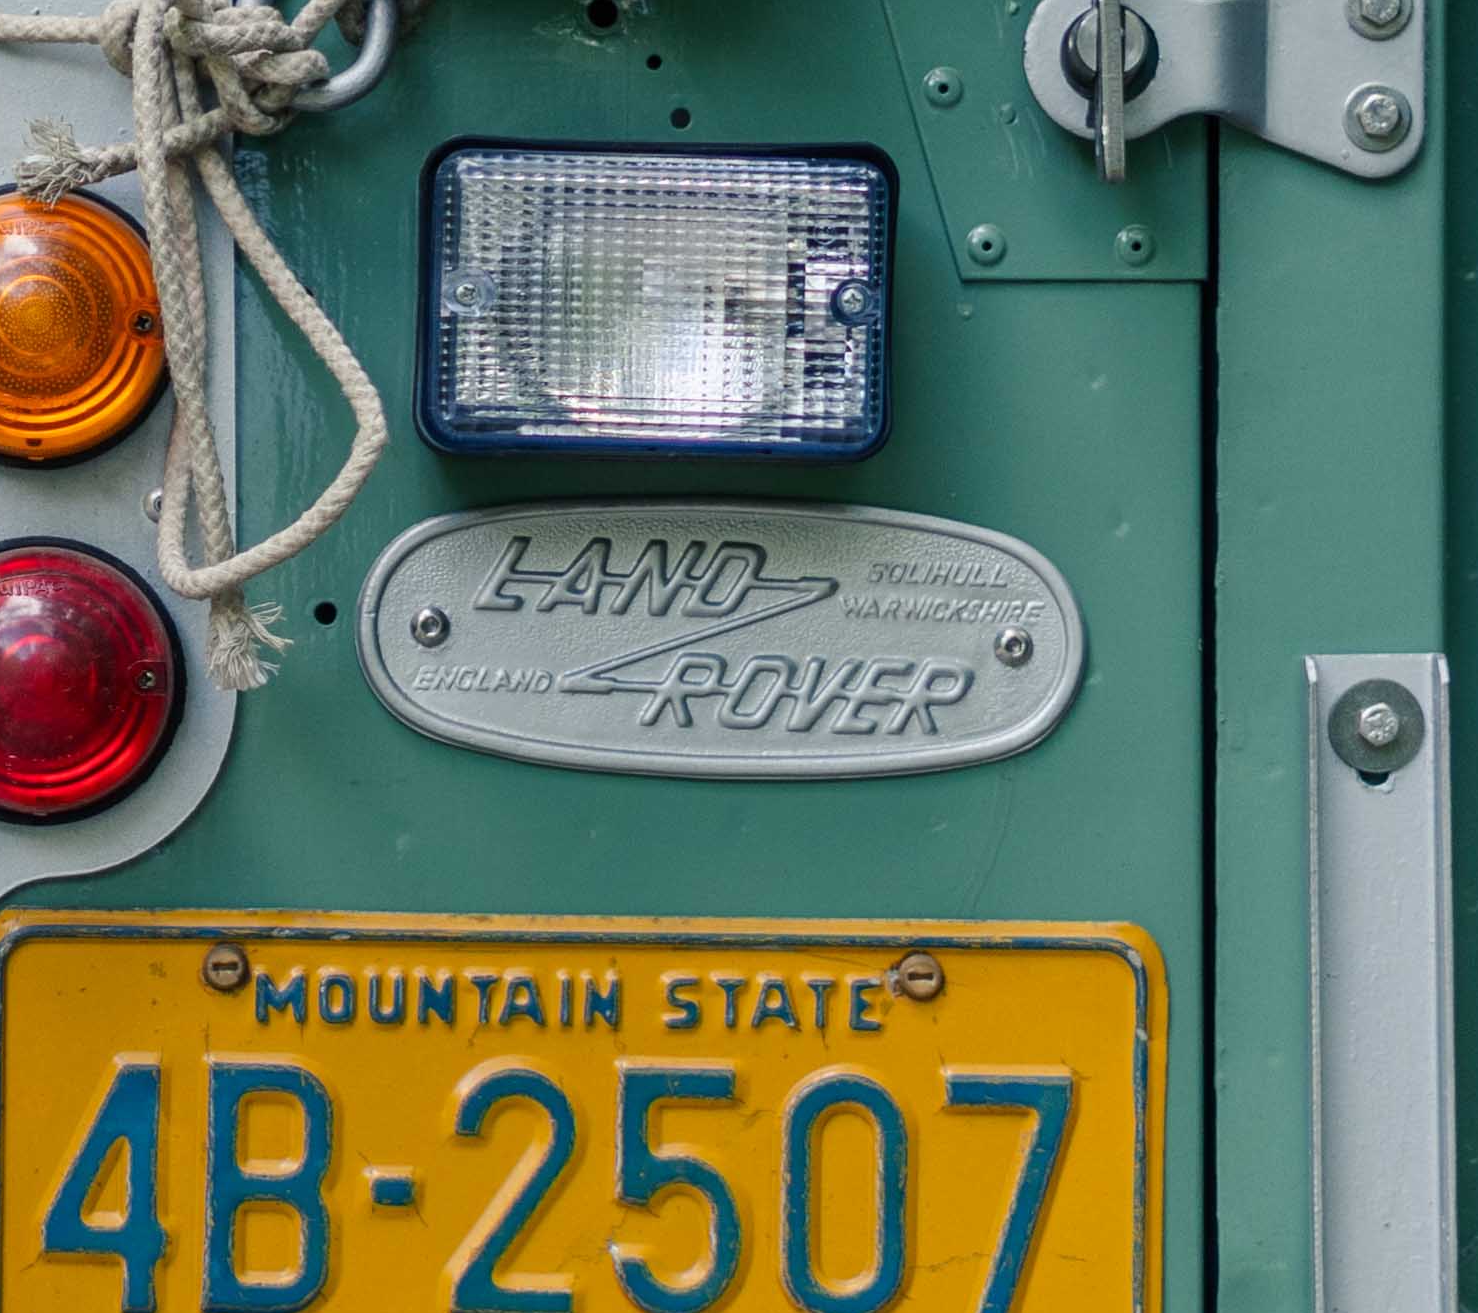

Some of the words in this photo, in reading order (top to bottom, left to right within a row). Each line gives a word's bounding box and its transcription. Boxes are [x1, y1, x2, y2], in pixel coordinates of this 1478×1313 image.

[473, 535, 771, 618] LAND
[866, 561, 1009, 589] SOLIHULL
[839, 593, 1046, 624] WARWICKSHIRE
[411, 665, 554, 694] ENGLAND
[638, 651, 977, 736] ROVER
[253, 968, 621, 1030] MOUNTAIN
[660, 973, 884, 1034] STATE
